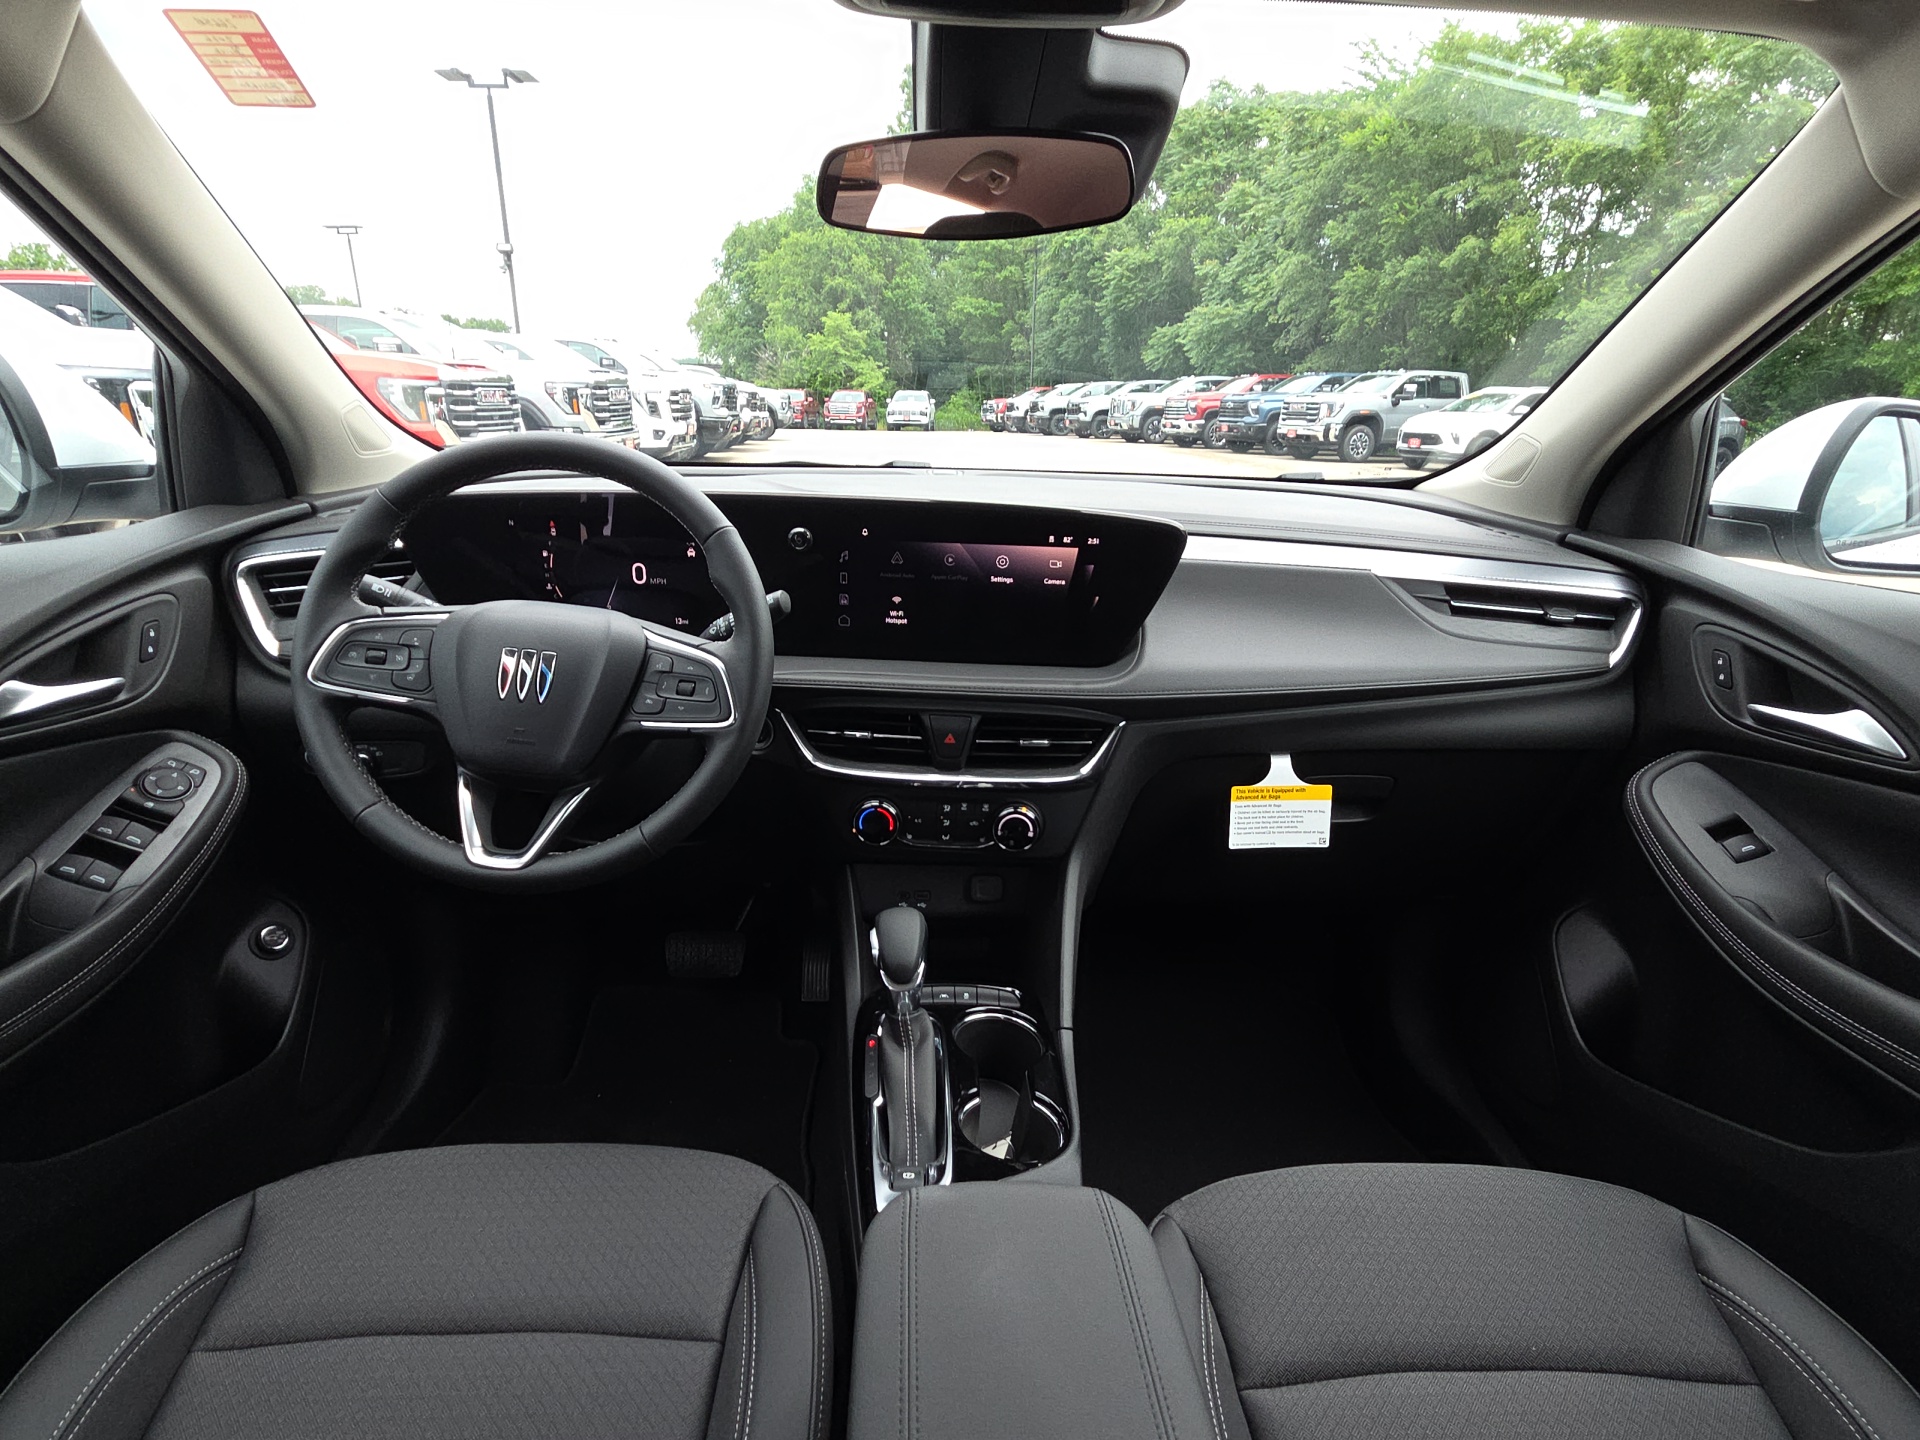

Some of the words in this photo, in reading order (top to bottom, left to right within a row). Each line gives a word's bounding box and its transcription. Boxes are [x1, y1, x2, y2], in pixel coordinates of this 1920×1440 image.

[631, 562, 647, 585] 0
[649, 577, 667, 585] MPH
[990, 575, 1014, 584] Settings
[1043, 577, 1066, 585] Camera
[885, 617, 908, 625] Hotspot
